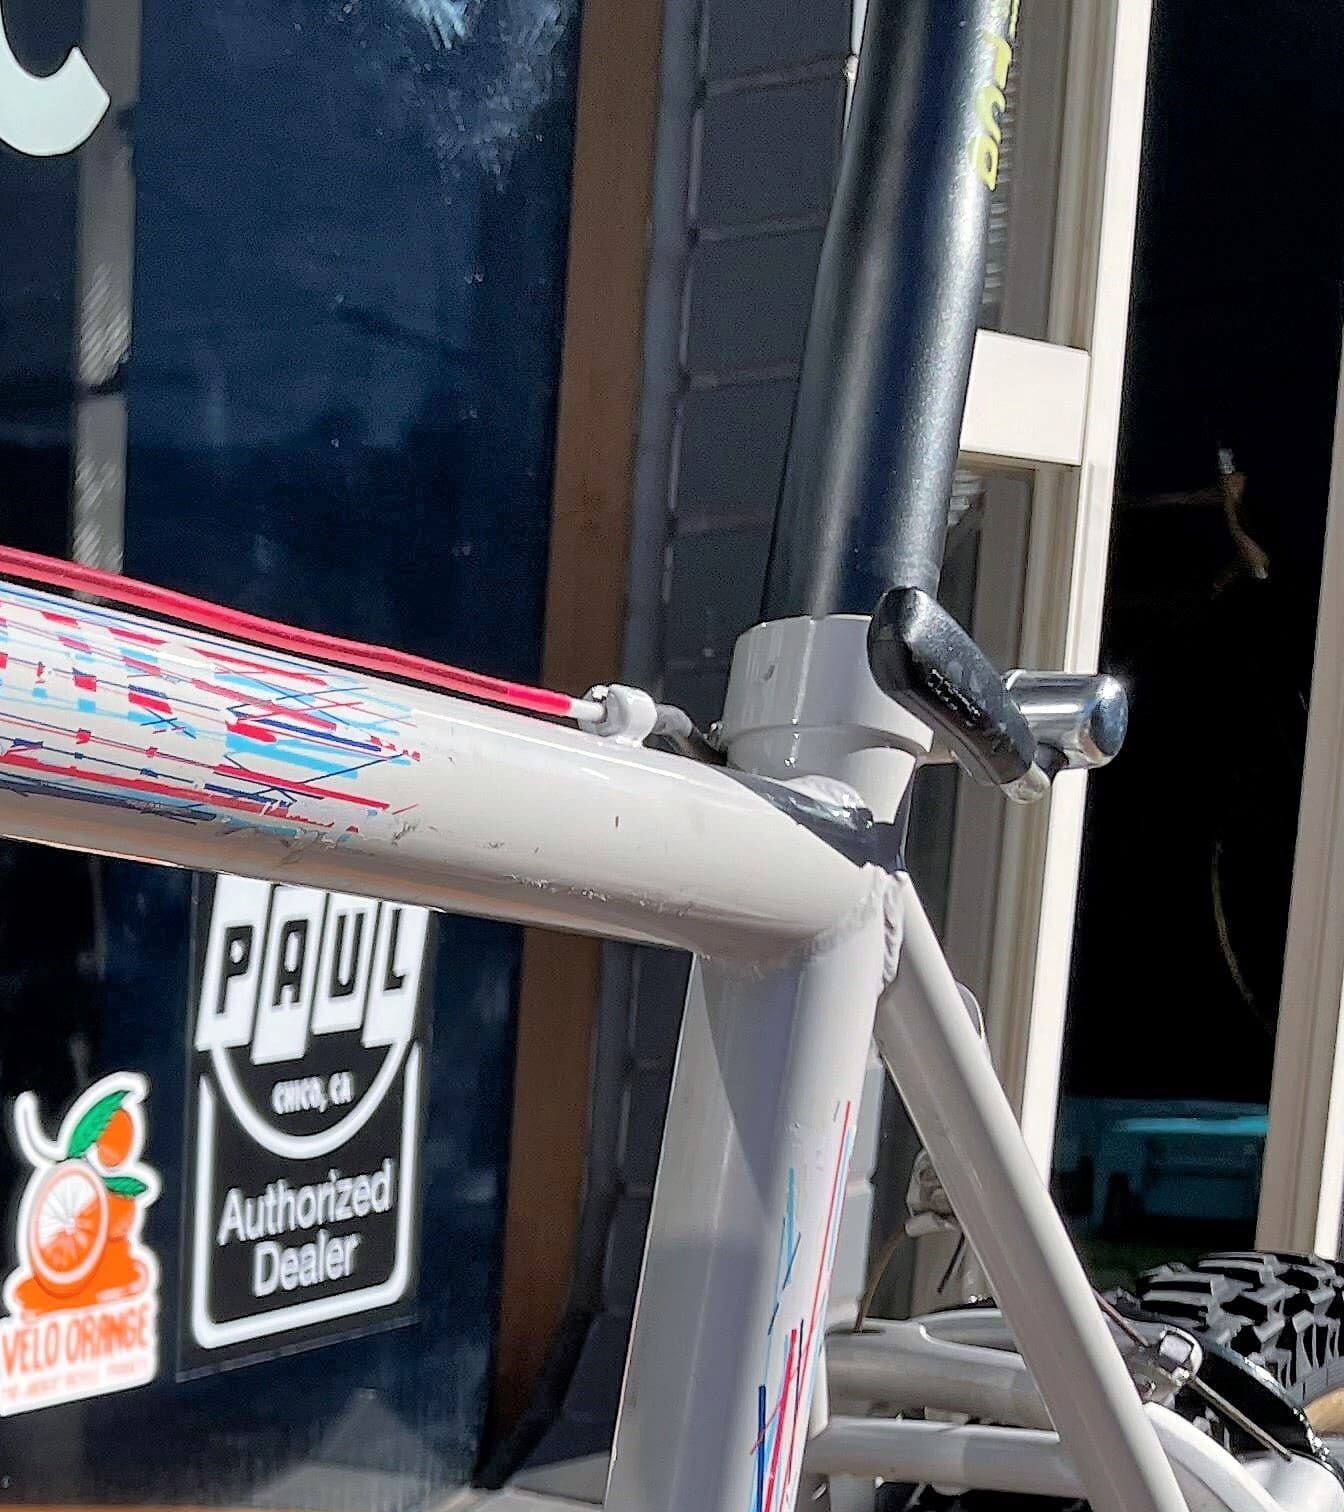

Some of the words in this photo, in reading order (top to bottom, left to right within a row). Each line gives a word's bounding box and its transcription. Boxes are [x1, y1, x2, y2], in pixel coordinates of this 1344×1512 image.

[216, 908, 405, 1014] PAUL
[216, 1157, 395, 1247] Authorized
[254, 1229, 361, 1297] Dealer
[1, 1321, 61, 1377] VELO
[65, 1301, 150, 1365] ORANGE
